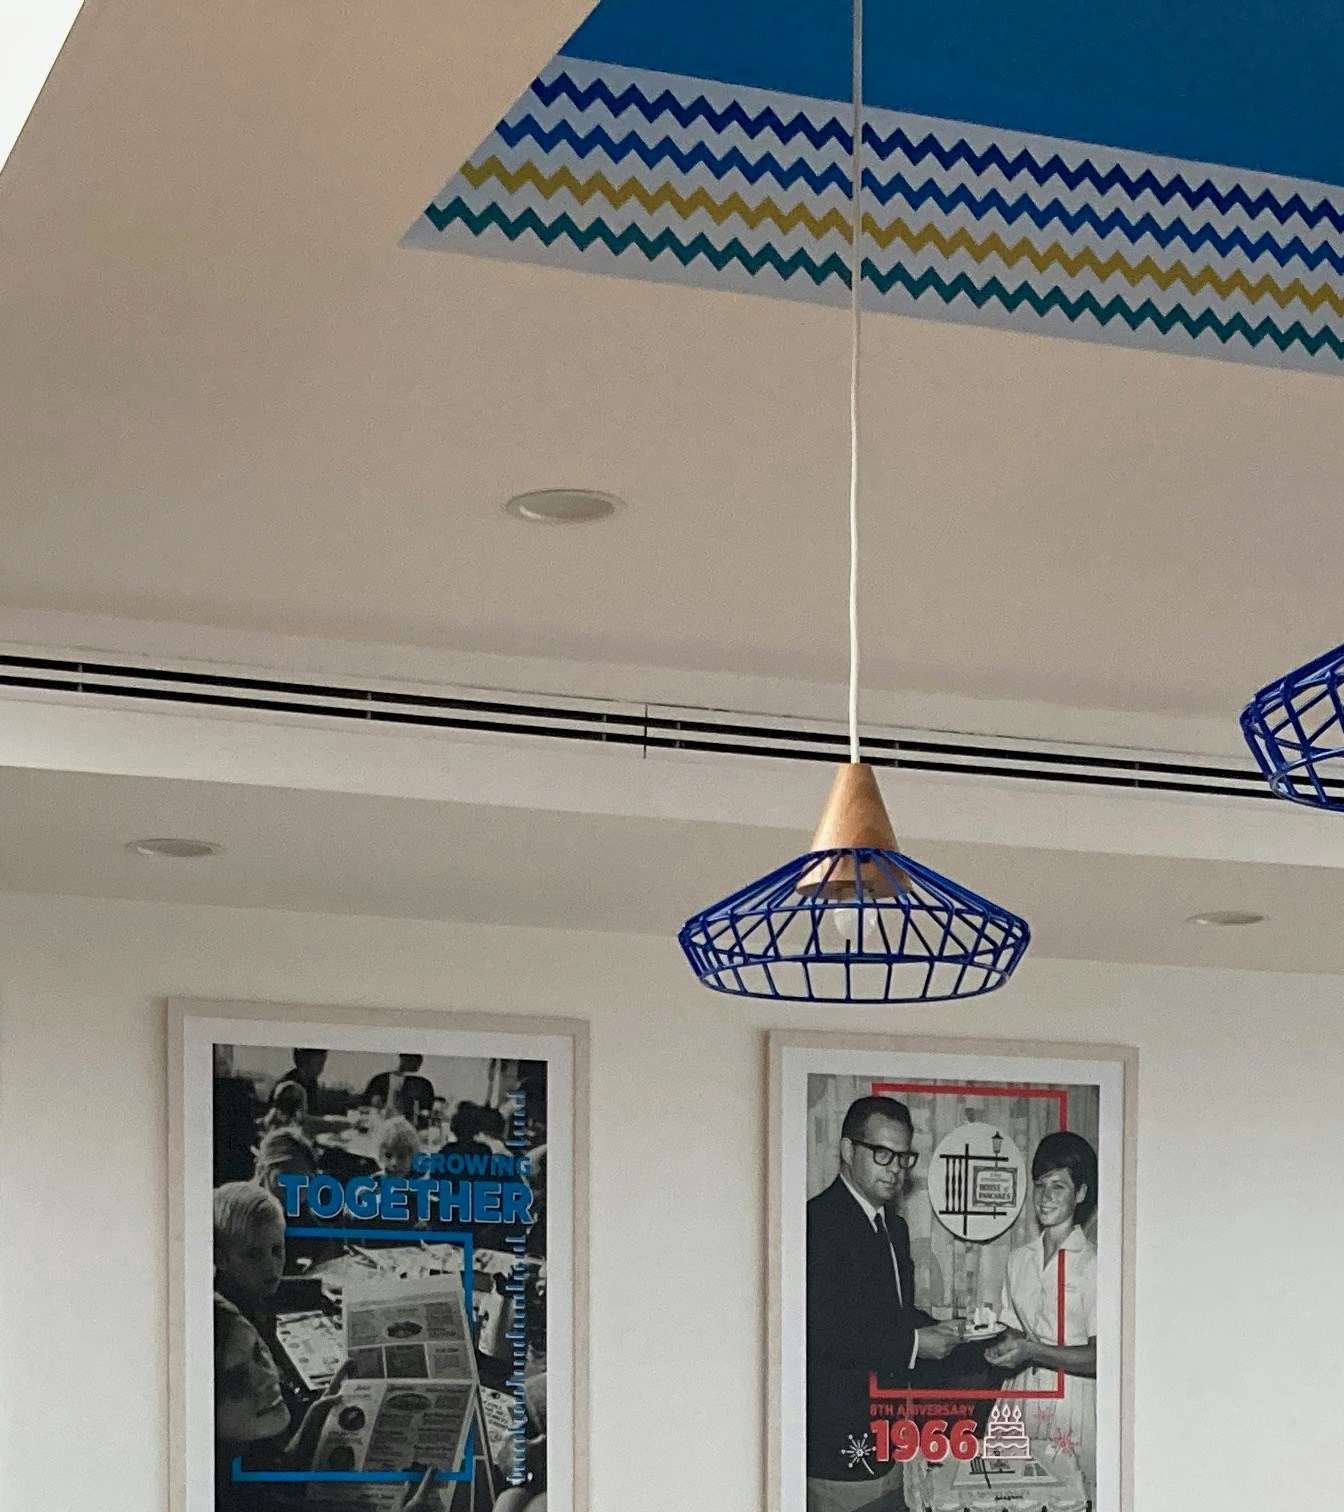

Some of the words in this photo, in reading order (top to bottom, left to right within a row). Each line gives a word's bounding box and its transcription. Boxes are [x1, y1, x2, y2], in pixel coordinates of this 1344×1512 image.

[412, 1153, 531, 1177] GROWING
[277, 1172, 536, 1225] TOGETHER
[870, 1419, 980, 1462] 1966
